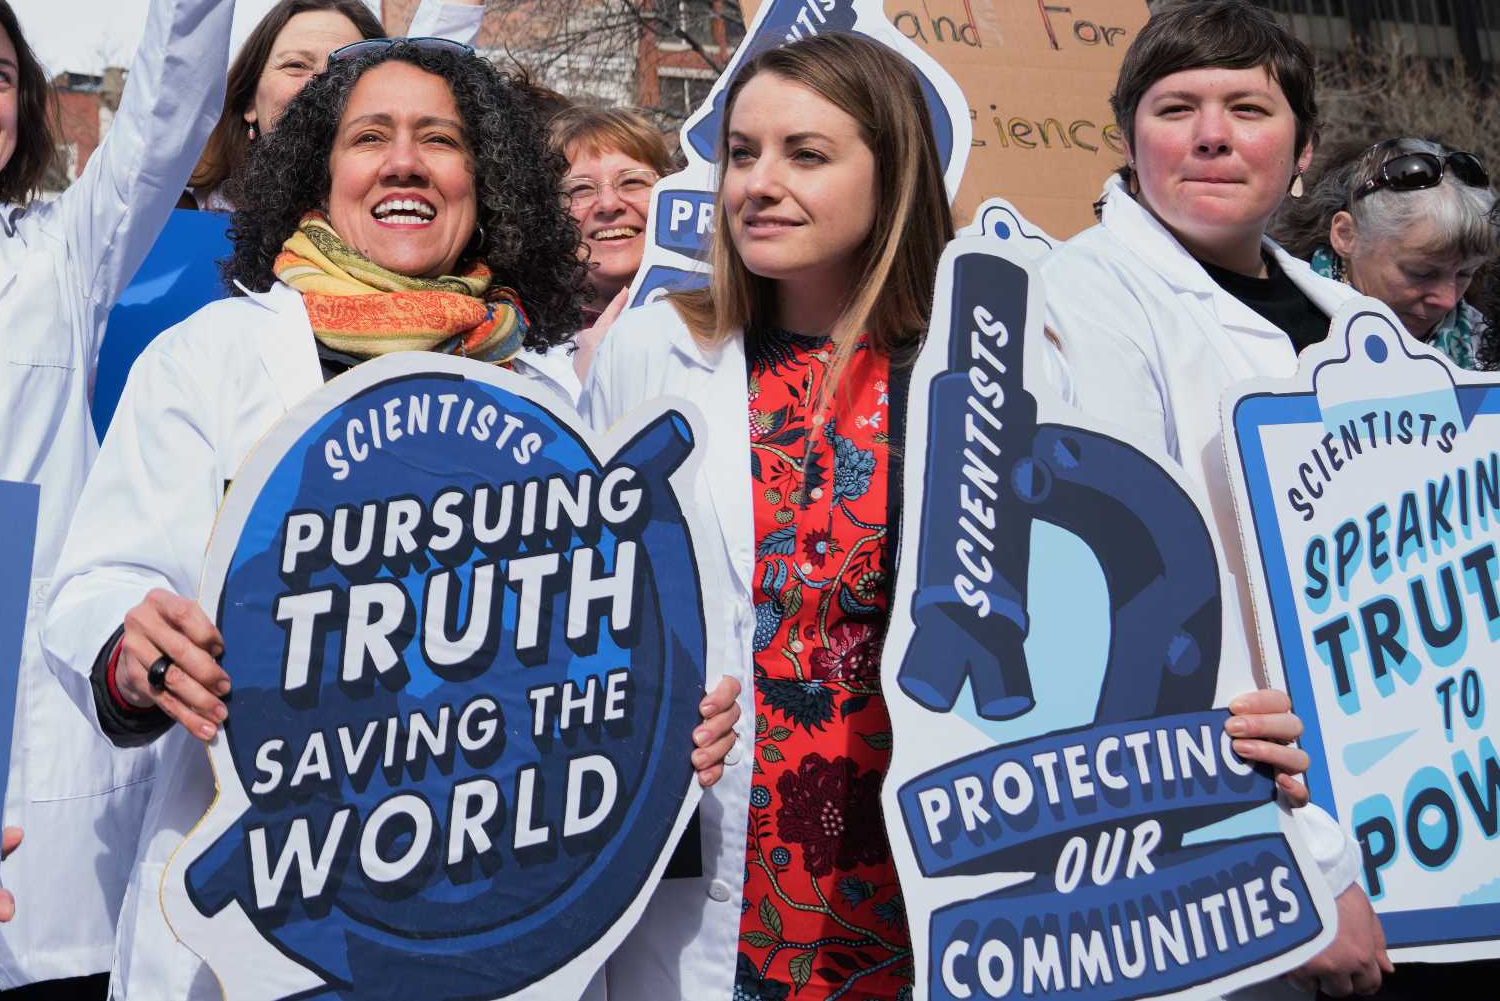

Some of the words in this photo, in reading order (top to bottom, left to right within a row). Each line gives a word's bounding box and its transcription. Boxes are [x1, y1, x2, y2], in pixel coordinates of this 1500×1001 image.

[324, 393, 542, 481] SCIENTISTS
[953, 305, 1009, 618] SCIENTISTS
[1287, 411, 1457, 521] SCIENTISTS
[282, 466, 643, 574] PURSUING
[276, 541, 637, 691] TRUTH
[251, 698, 497, 795] SAVING
[529, 671, 629, 736] THE
[1436, 667, 1480, 730] TO
[248, 753, 618, 910] WORLD
[1055, 819, 1164, 895] OUR
[942, 866, 1301, 1000] COMMUNITIES
